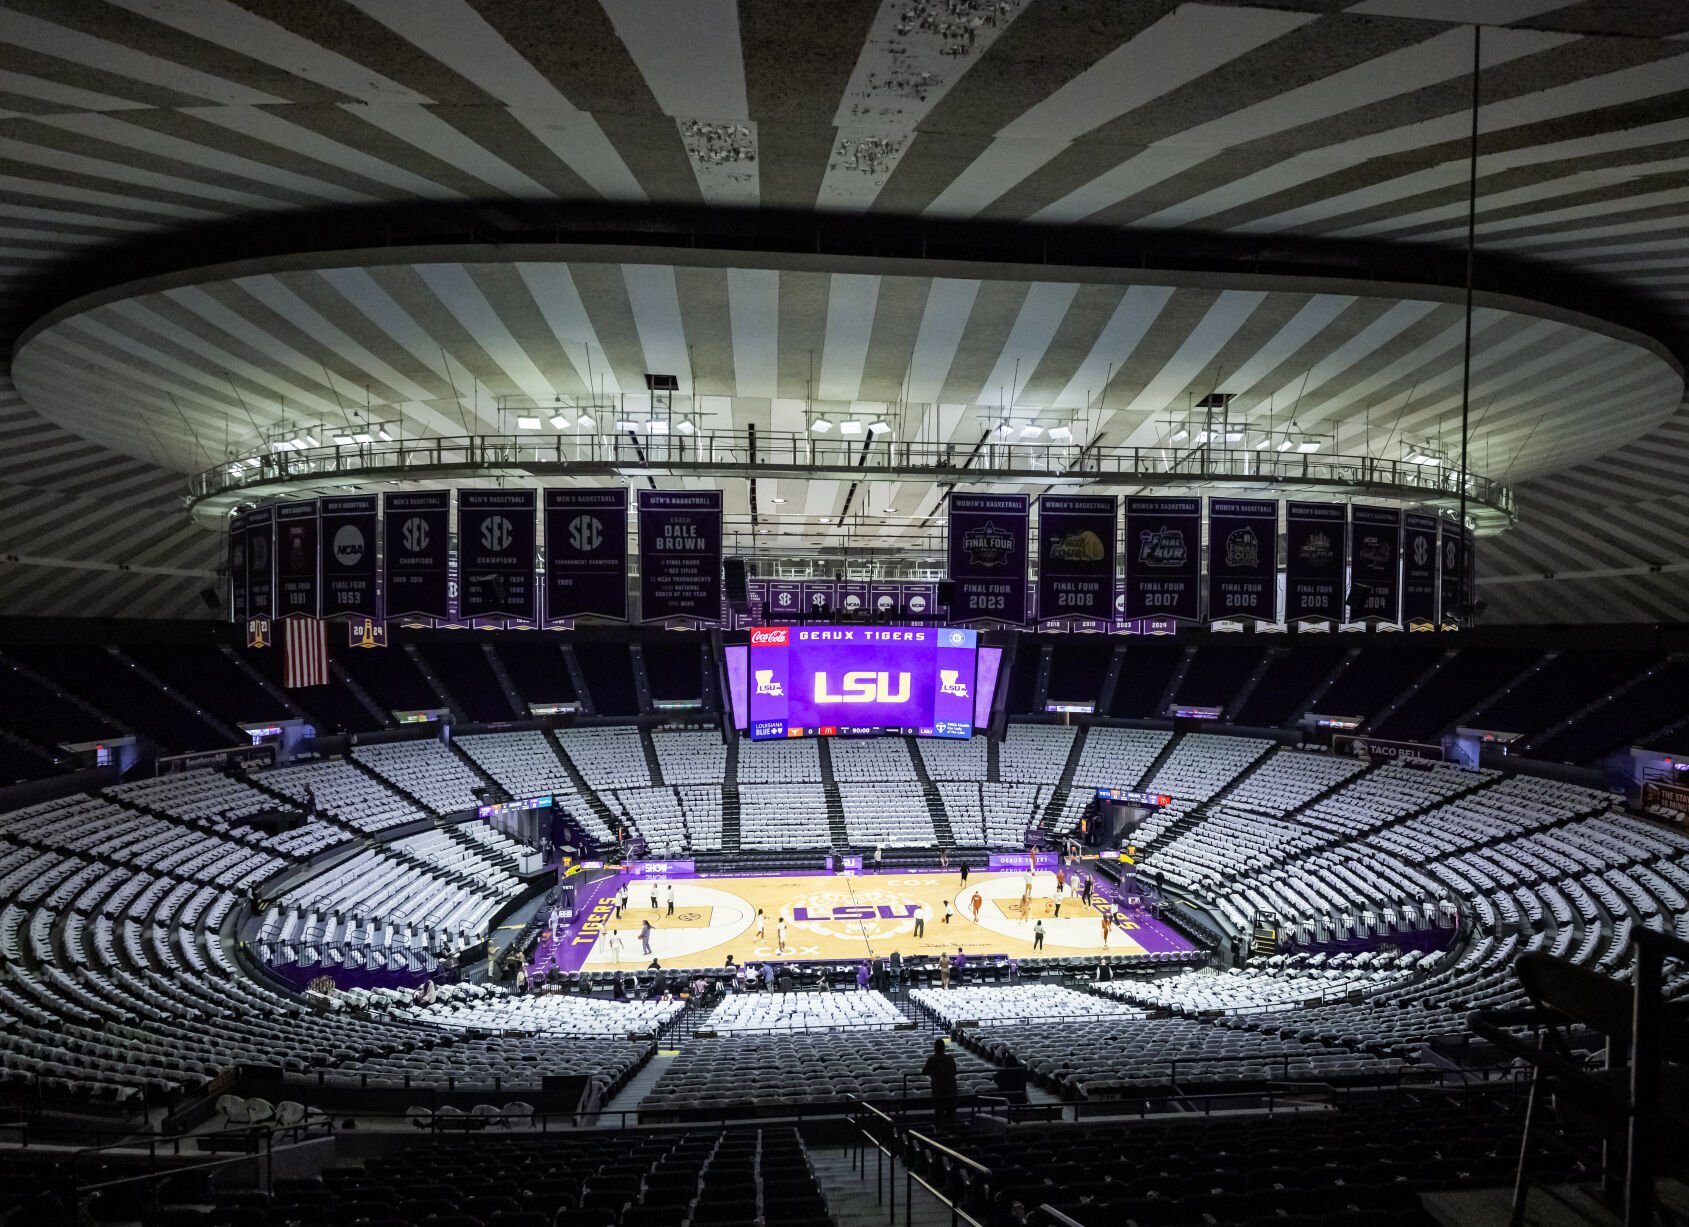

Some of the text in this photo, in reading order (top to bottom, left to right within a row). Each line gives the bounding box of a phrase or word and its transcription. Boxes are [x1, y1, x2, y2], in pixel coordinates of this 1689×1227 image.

[955, 500, 984, 508] WOMEN'S
[402, 517, 430, 552] SEC
[480, 515, 512, 551] SEC
[569, 514, 603, 551] SEC
[664, 525, 697, 537] DALE
[337, 544, 363, 555] NCAA
[656, 538, 705, 550] BROWN
[965, 539, 1013, 550] FINAL FOUR
[964, 584, 1011, 593] FINAL FOUR
[1053, 582, 1099, 591] FINAL FOUR
[1140, 582, 1184, 591] FINAL FOUR
[1222, 583, 1262, 592] FINAL FOUR
[1297, 585, 1333, 593] FINAL FOUR
[337, 592, 361, 604] 1953
[778, 592, 792, 606] SEC
[969, 595, 1005, 608] 2023
[1058, 593, 1094, 606] 2008
[1145, 593, 1179, 606] 2007
[1226, 594, 1257, 607] 2006
[1301, 596, 1329, 608] 2005
[354, 626, 364, 636] 20
[752, 630, 788, 643] Coca-Cola
[800, 632, 925, 641] GEAUX TIGERS
[814, 672, 911, 703] LSU
[756, 728, 771, 736] BLUE
[1369, 745, 1397, 756] TACO
[1662, 791, 1674, 801] THE
[888, 879, 939, 887] COX
[793, 905, 921, 921] LSU
[572, 897, 617, 946] TIGERS
[753, 946, 820, 956] COX
